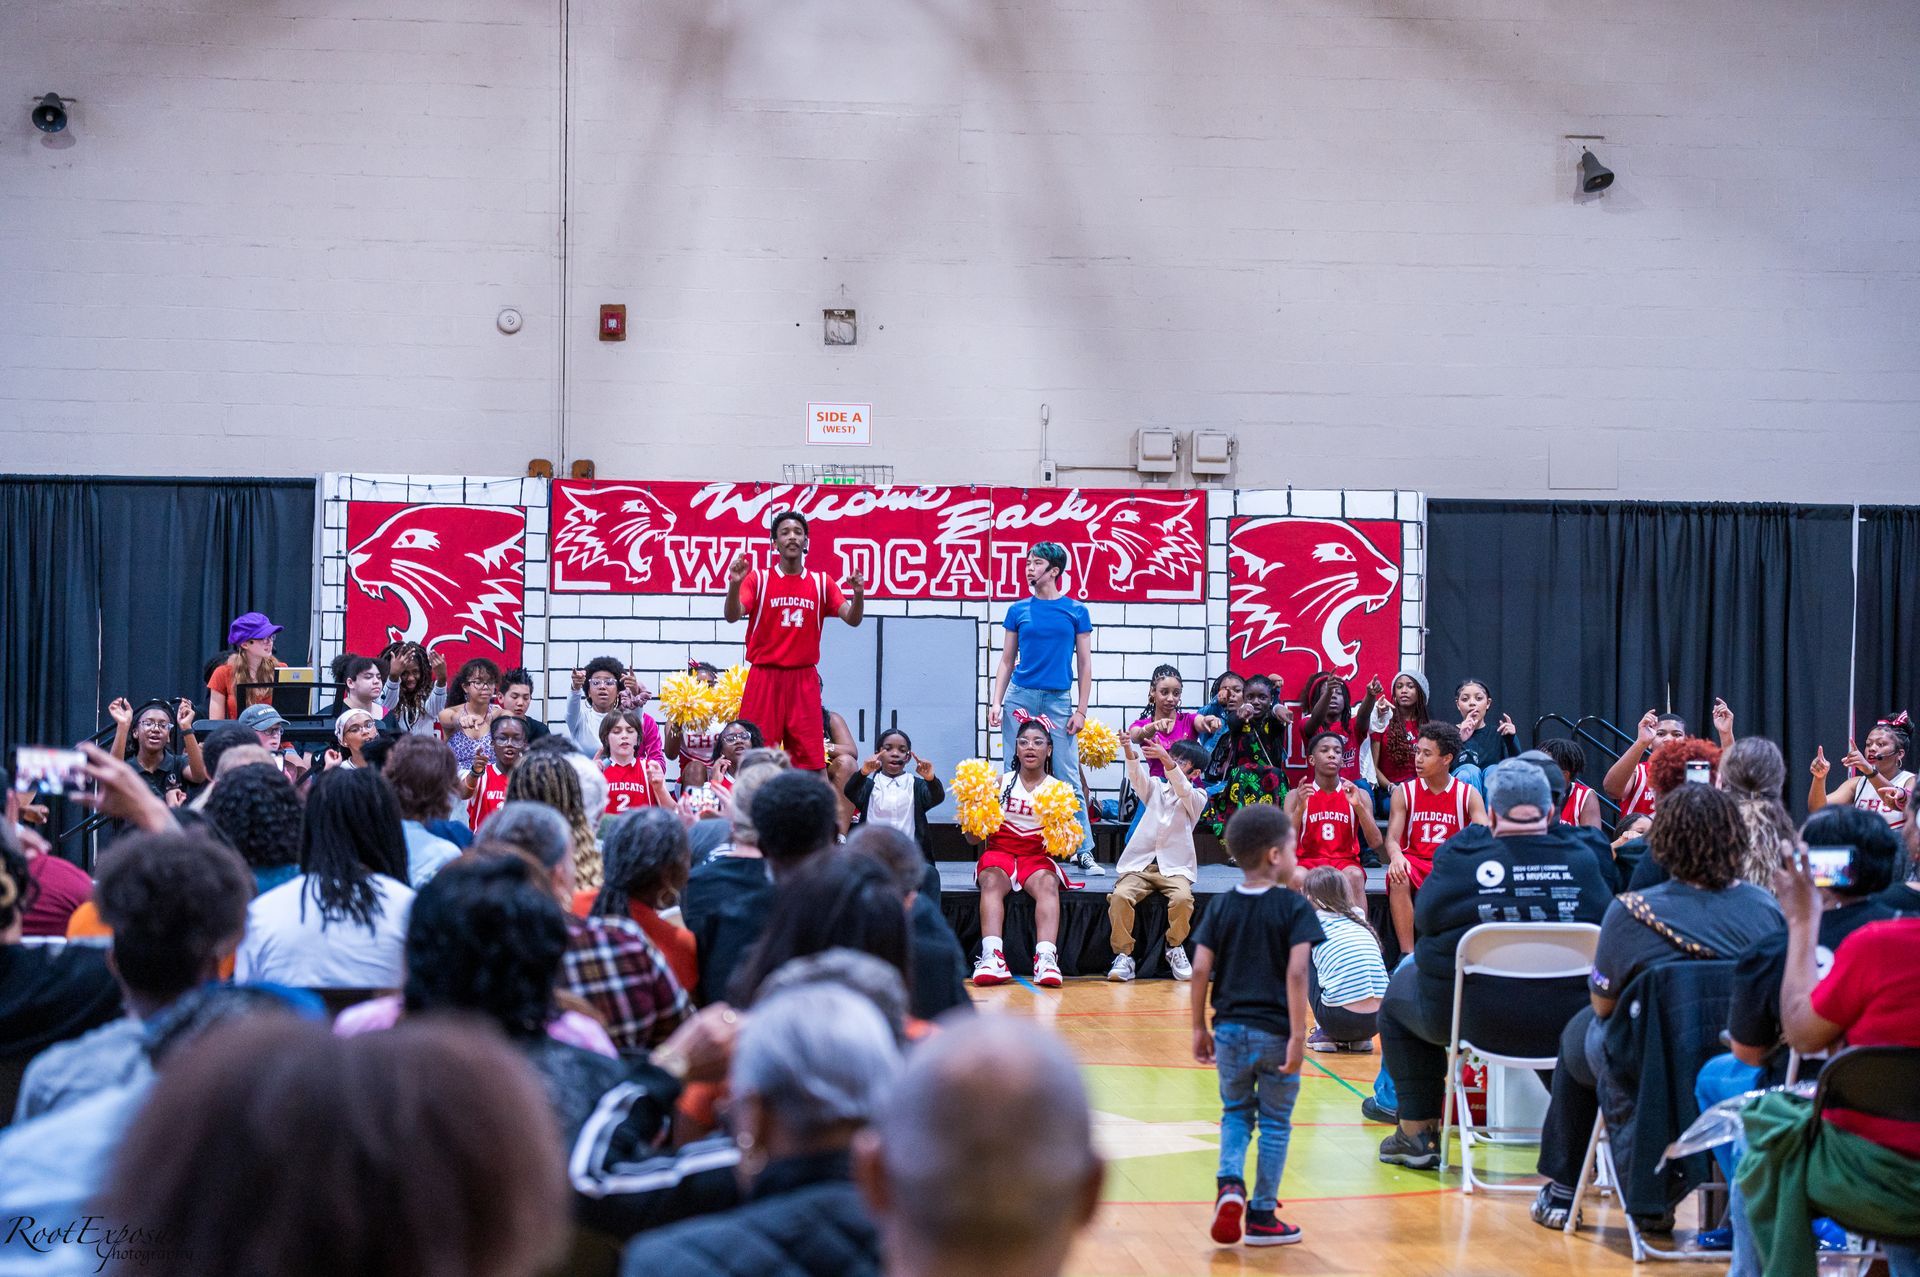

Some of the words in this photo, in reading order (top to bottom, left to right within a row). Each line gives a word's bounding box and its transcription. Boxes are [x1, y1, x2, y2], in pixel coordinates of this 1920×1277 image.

[816, 411, 848, 423] SIDE
[852, 412, 862, 423] A
[822, 425, 856, 434] (WEST)
[689, 482, 951, 530] Welcome
[933, 487, 1098, 544] Back
[664, 535, 1098, 600] WIDCAT!
[770, 596, 815, 611] WILDCATS
[780, 607, 805, 628] 14
[687, 733, 719, 749] EH
[616, 793, 631, 812] 2
[1006, 797, 1033, 816] EH
[1309, 811, 1349, 824] WILDCATS
[1412, 811, 1456, 825] WILDCATS
[1321, 822, 1335, 841] 8
[1420, 822, 1448, 844] 12
[1526, 872, 1561, 881] MUSICAL
